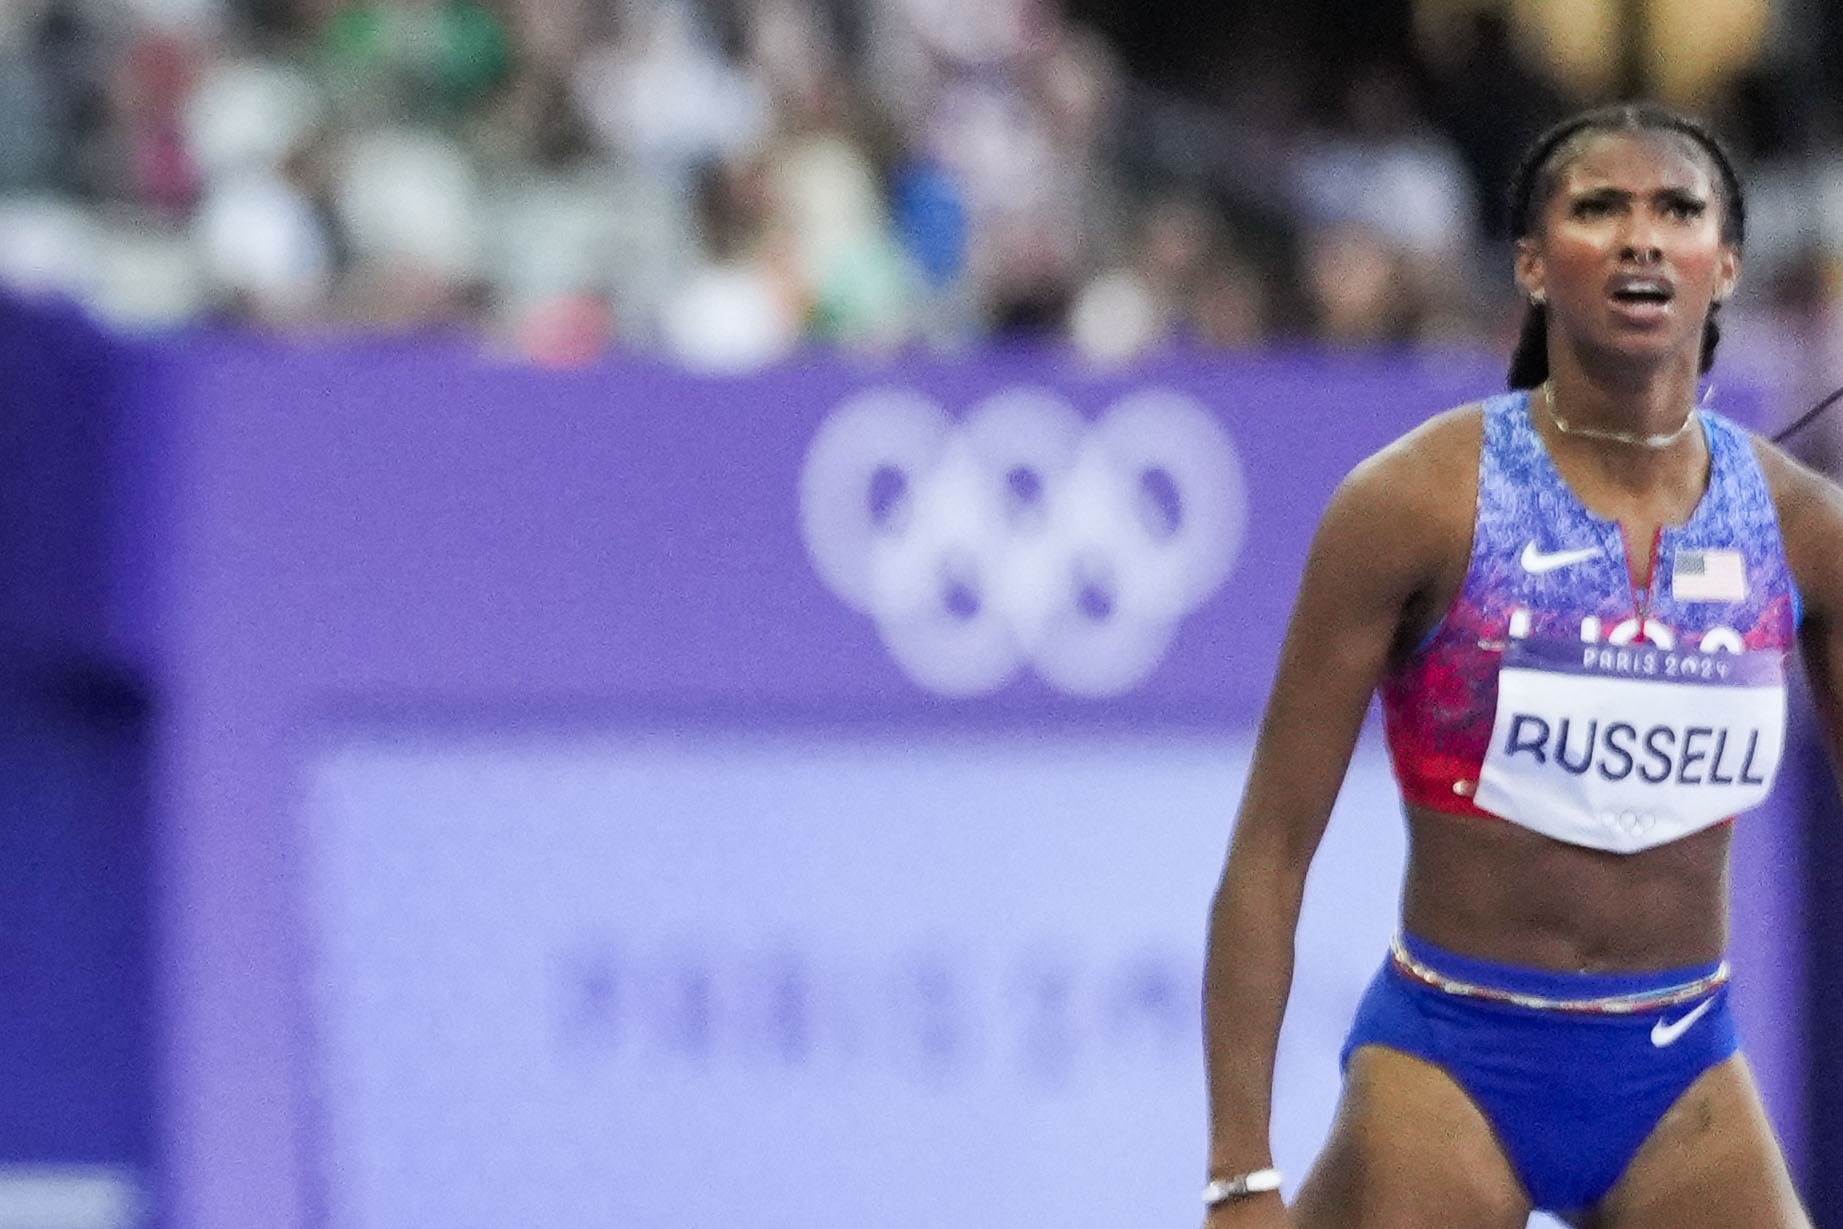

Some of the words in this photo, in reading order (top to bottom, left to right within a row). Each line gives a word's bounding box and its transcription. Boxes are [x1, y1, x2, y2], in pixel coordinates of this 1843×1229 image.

[1582, 648, 1657, 677] PARIS
[1664, 656, 1729, 679] 2024
[1505, 712, 1763, 785] RUSSELL
